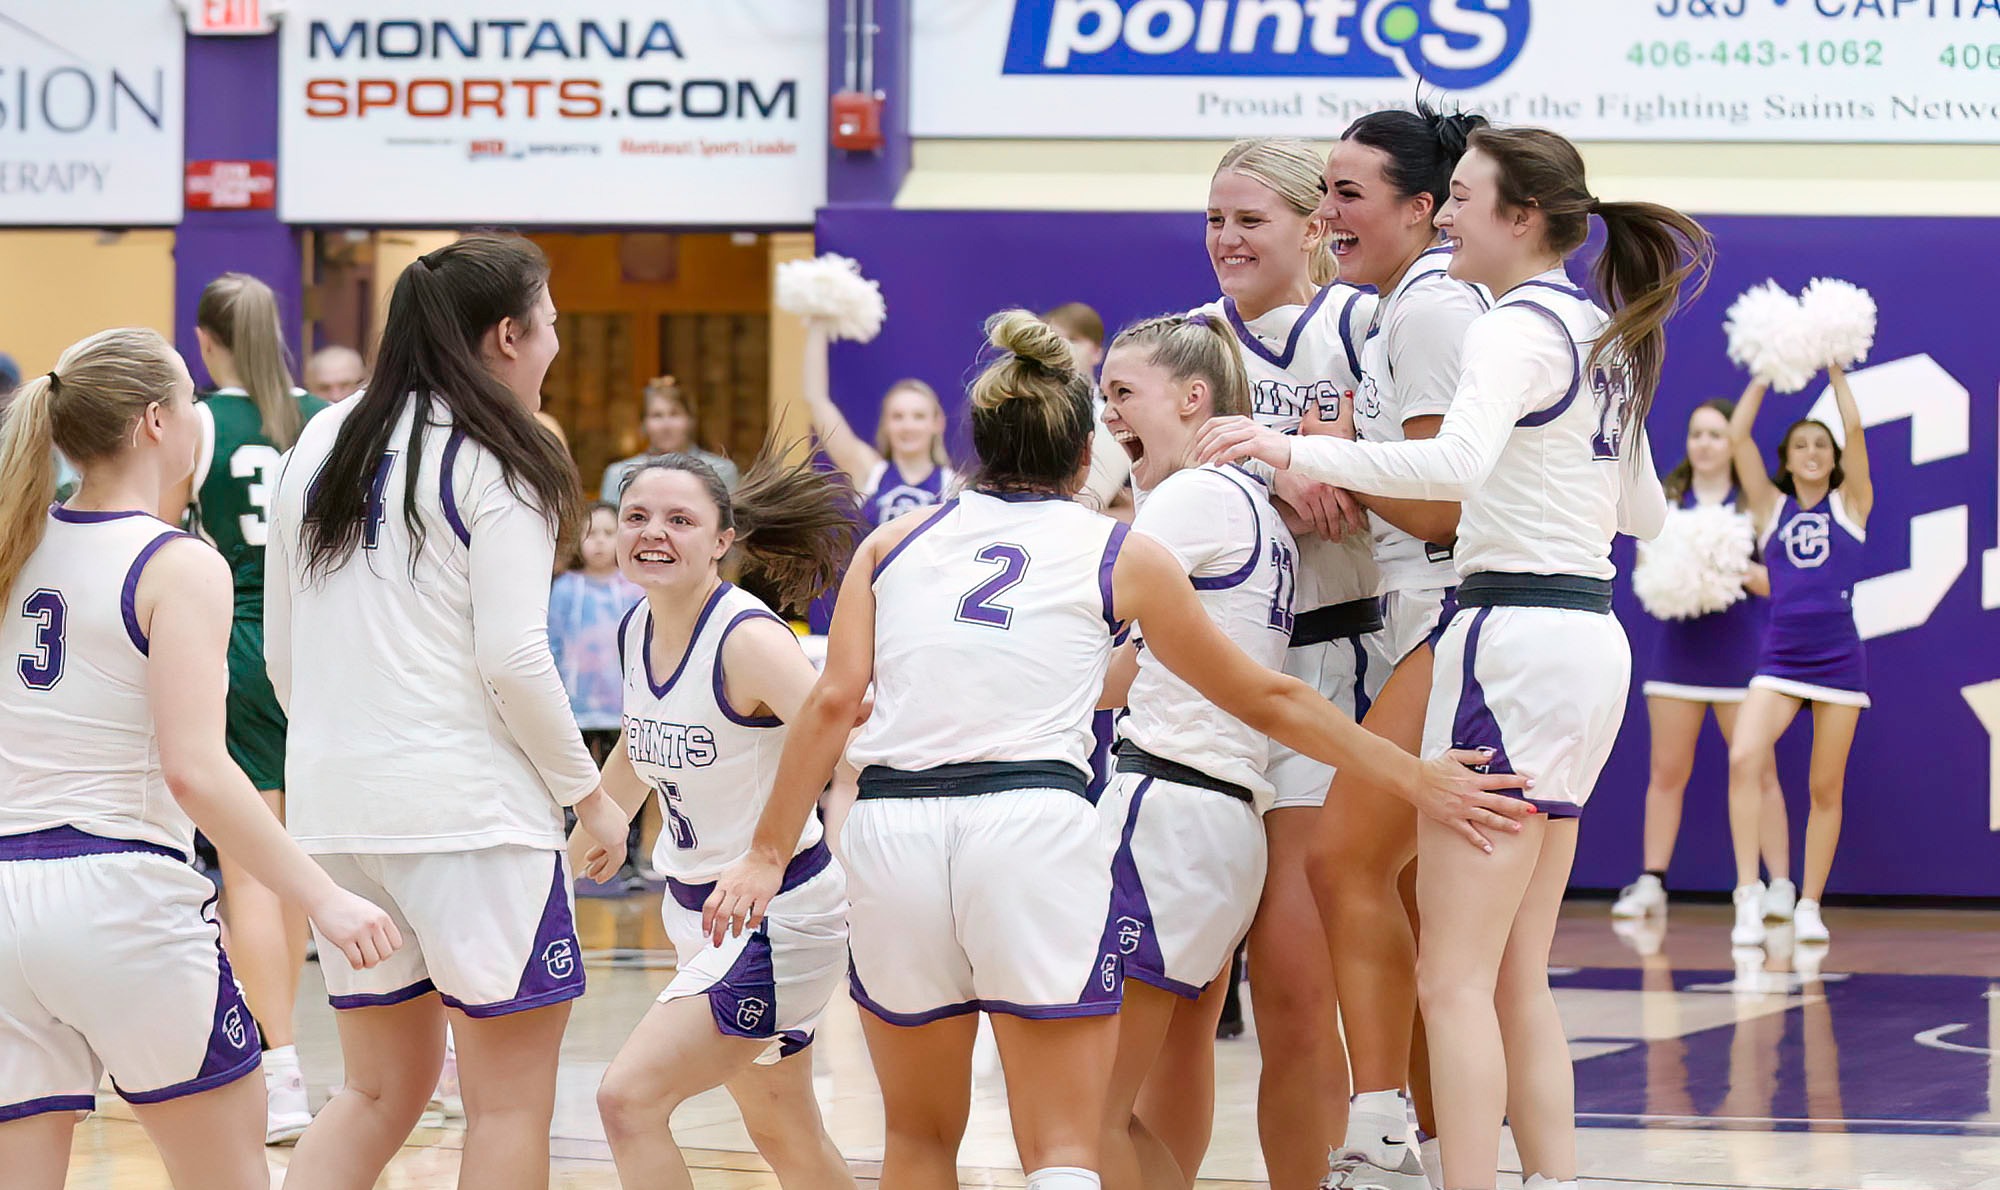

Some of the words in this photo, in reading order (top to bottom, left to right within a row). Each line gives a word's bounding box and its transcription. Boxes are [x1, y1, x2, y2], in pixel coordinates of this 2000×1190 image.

[308, 19, 685, 60] MONTANA
[1043, 0, 1358, 69] point
[1625, 40, 1884, 68] 406-443-1062
[0, 66, 164, 134] ION
[305, 78, 798, 119] SPORTS.COM
[1196, 93, 1302, 117] Proud
[1527, 92, 1582, 119] the
[1595, 93, 1750, 124] Fighting
[1765, 95, 1876, 119] Saints
[954, 541, 1032, 630] 2
[16, 587, 68, 691] 3
[622, 714, 717, 769] AINTS
